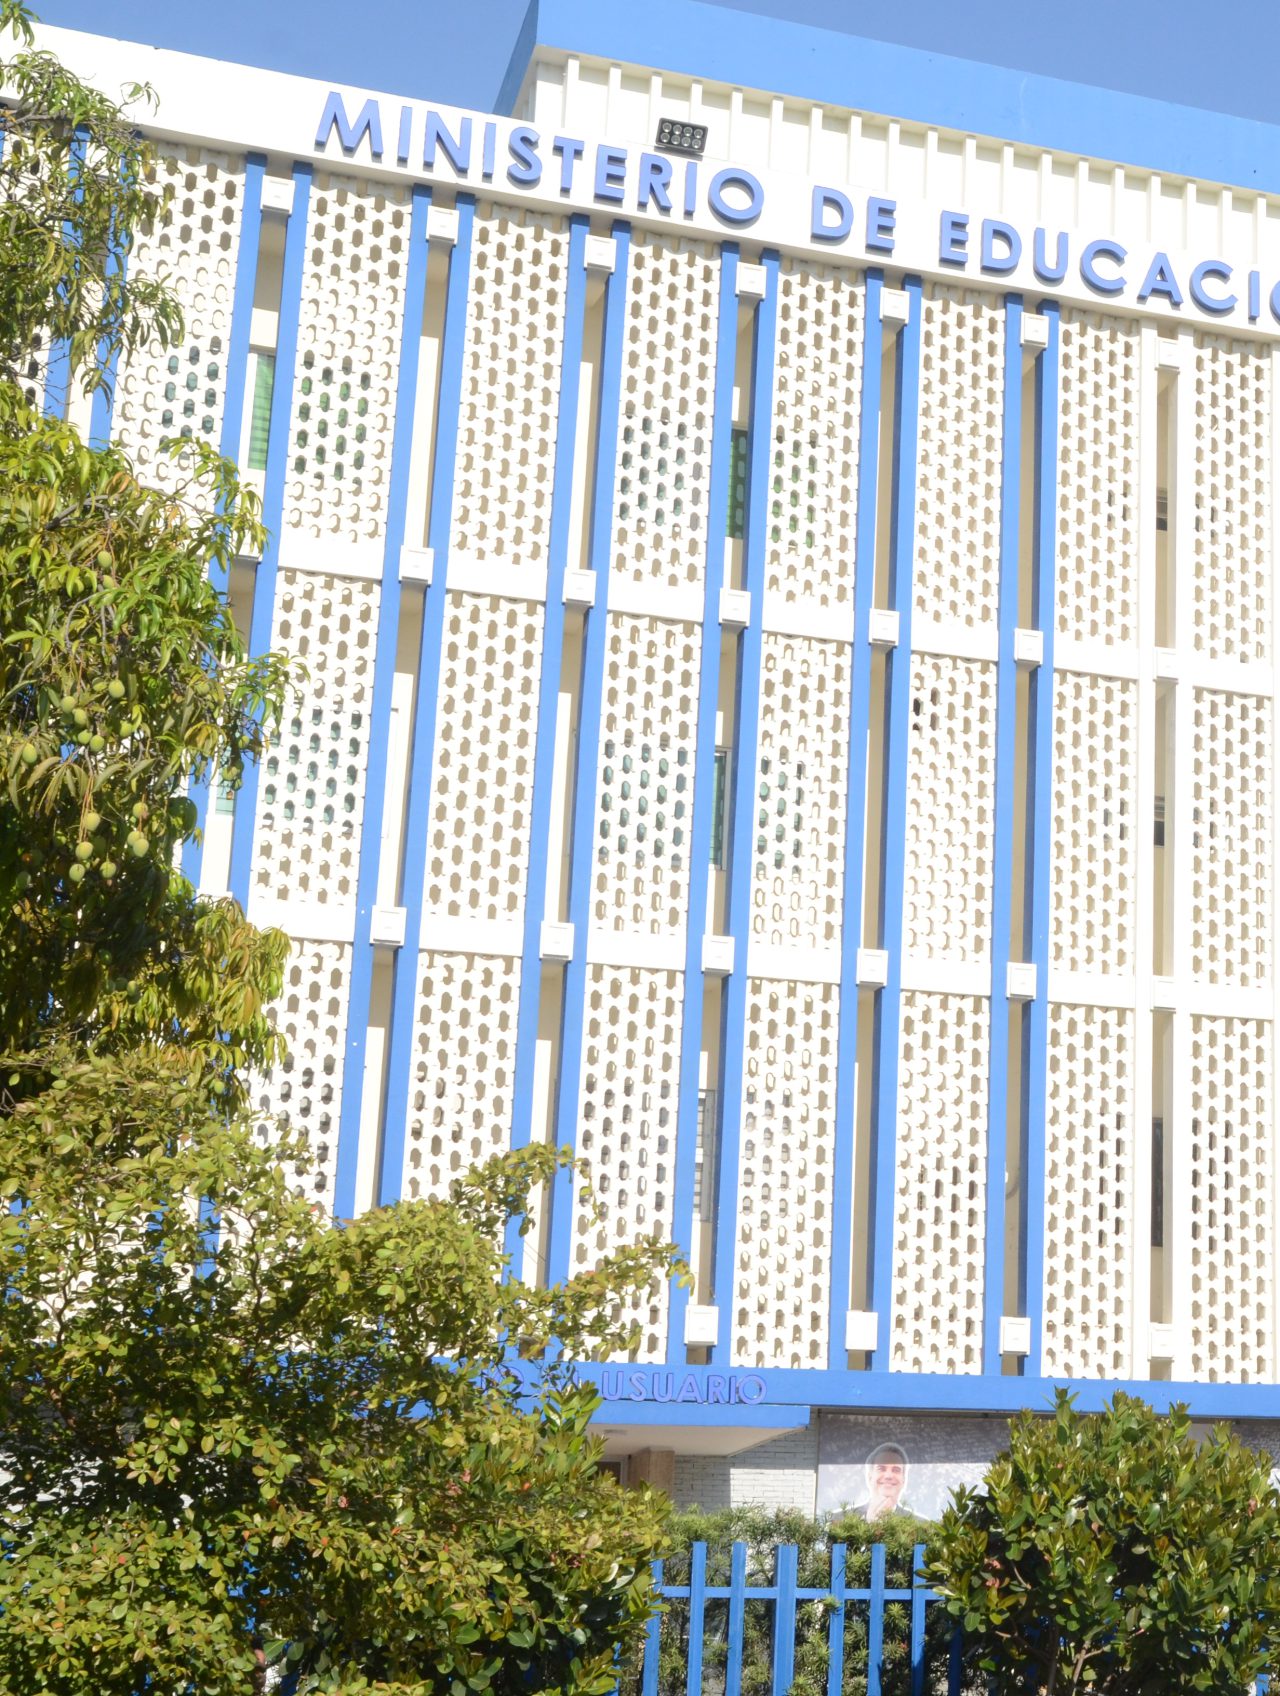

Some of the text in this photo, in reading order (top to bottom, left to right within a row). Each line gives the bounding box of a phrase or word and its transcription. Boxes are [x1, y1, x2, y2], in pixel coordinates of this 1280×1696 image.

[314, 91, 765, 224] MINISTERIO
[811, 186, 898, 252] DE
[601, 1370, 767, 1405] USUARIO
